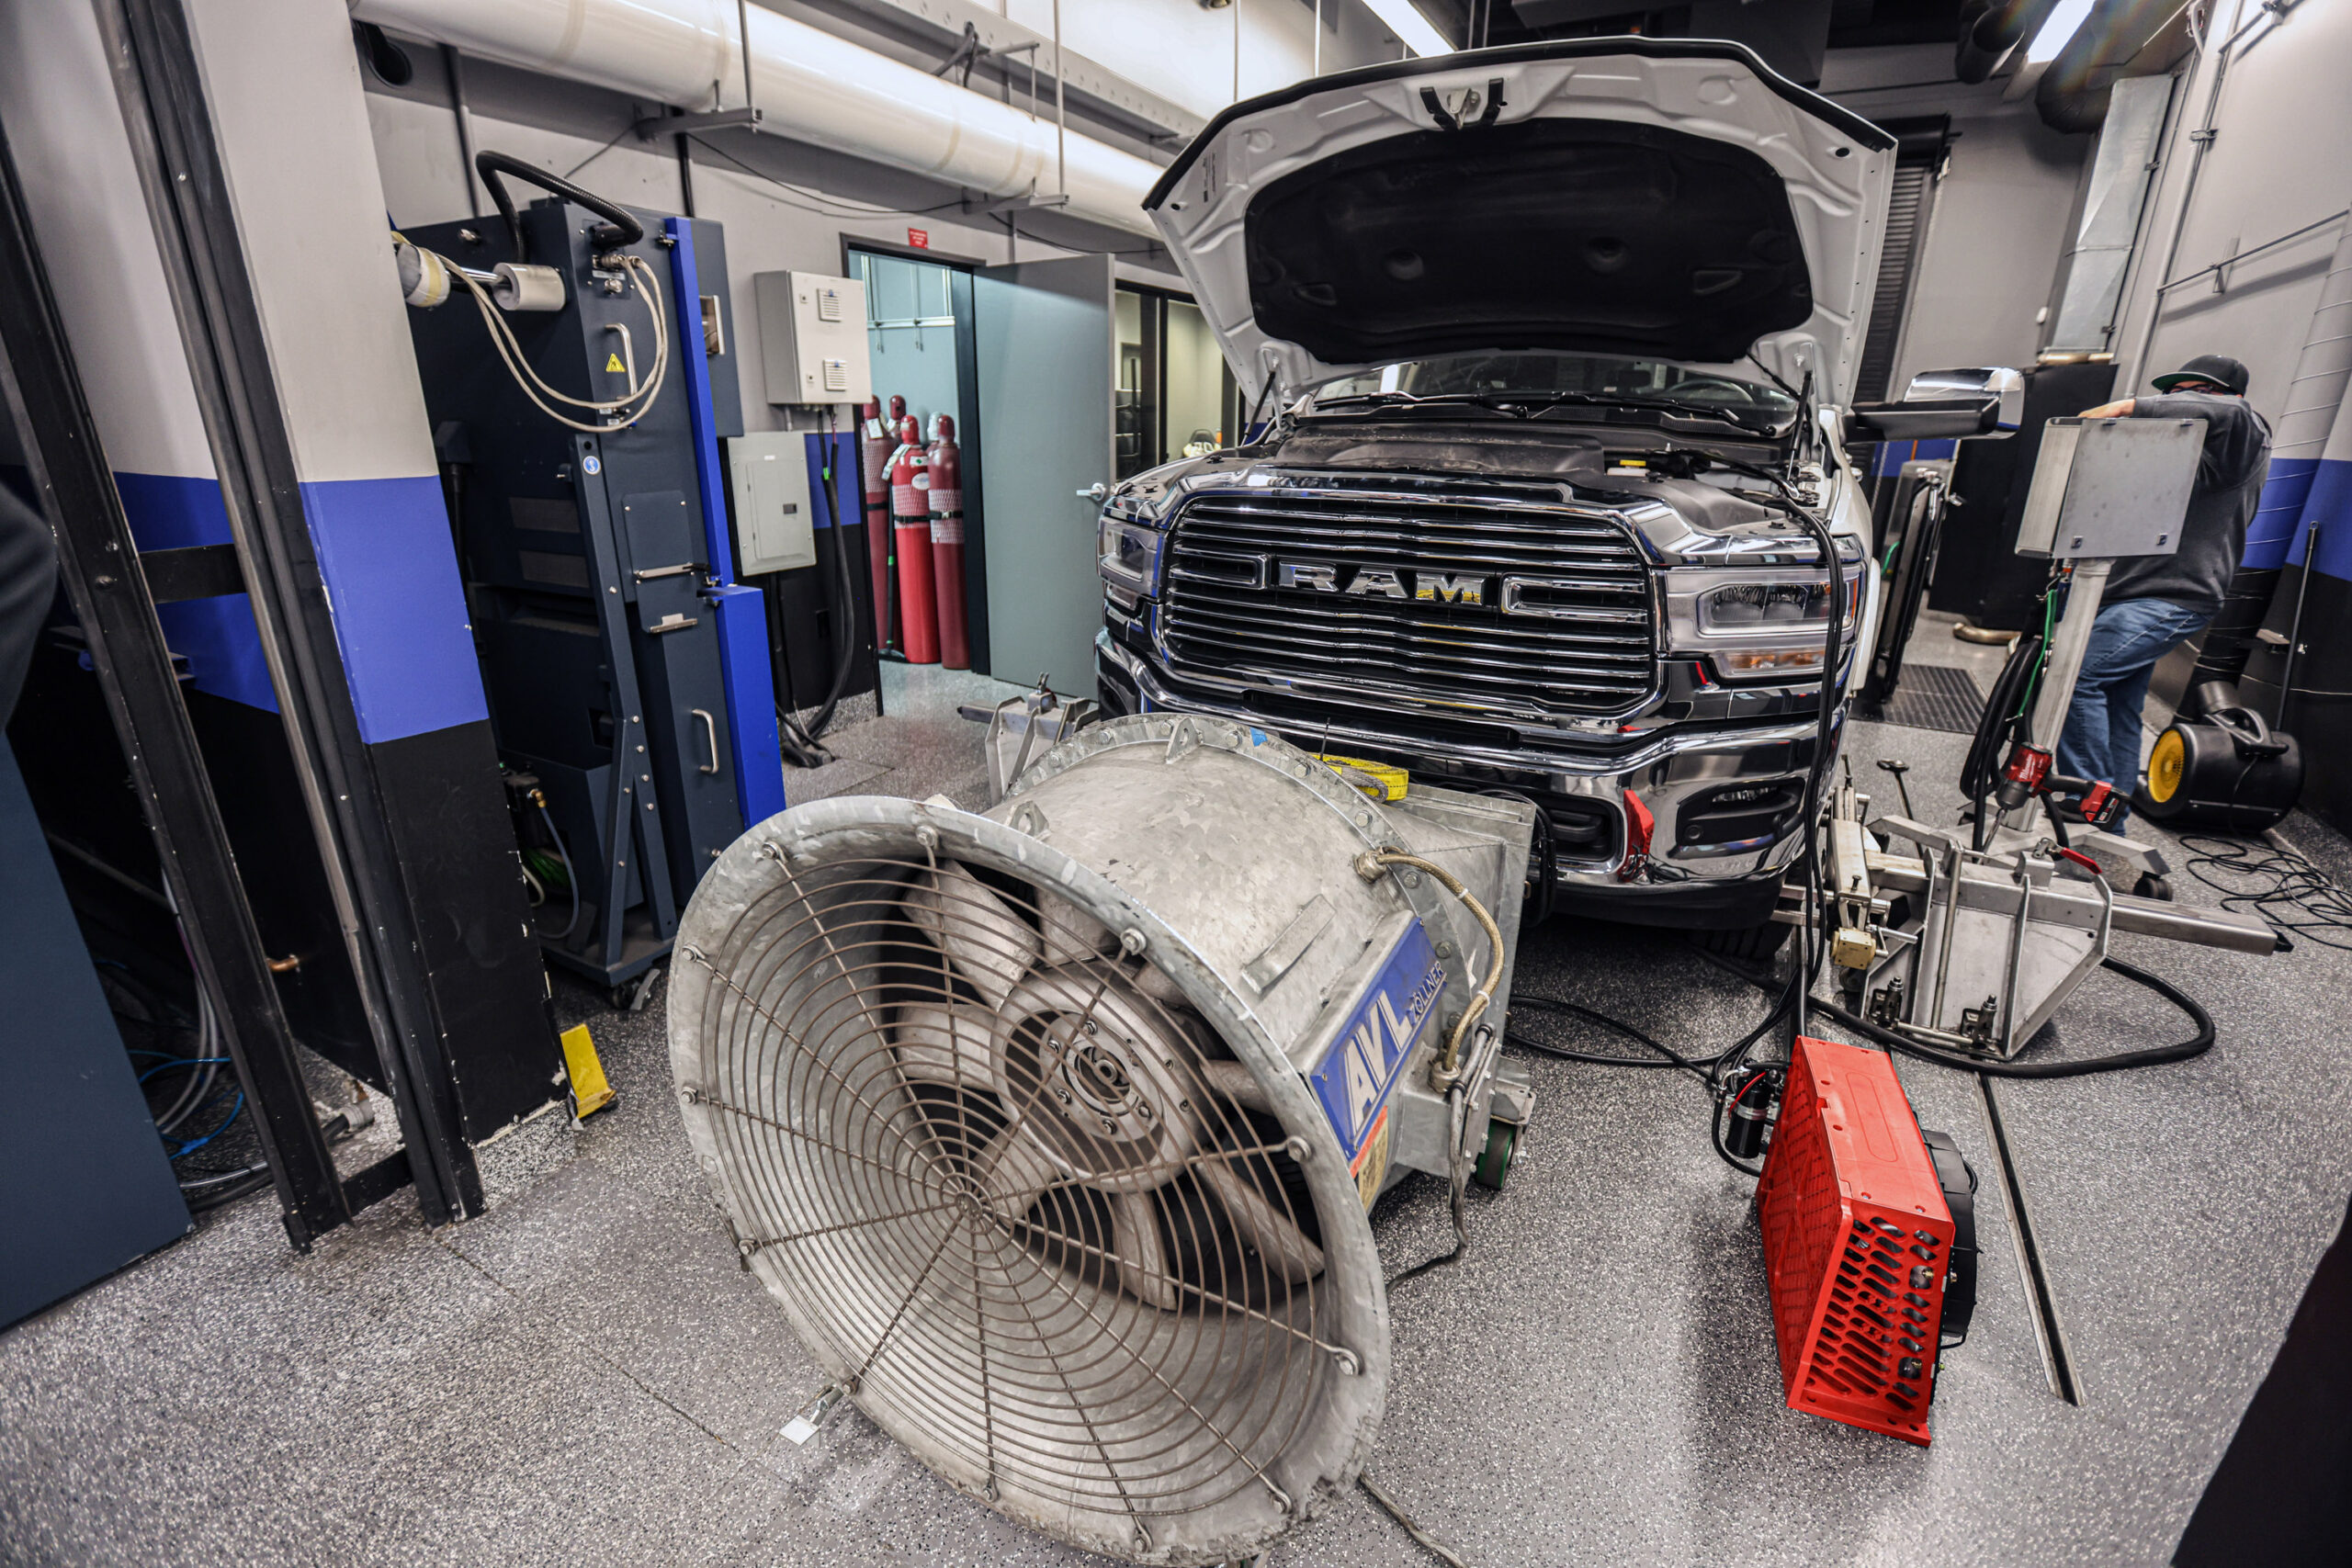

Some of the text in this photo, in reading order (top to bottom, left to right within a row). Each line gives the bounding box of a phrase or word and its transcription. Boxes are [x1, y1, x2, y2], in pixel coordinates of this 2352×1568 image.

[1279, 561, 1486, 605] RAM
[1344, 989, 1413, 1136] AVL
[1408, 961, 1443, 1022] ZÖLLNER
